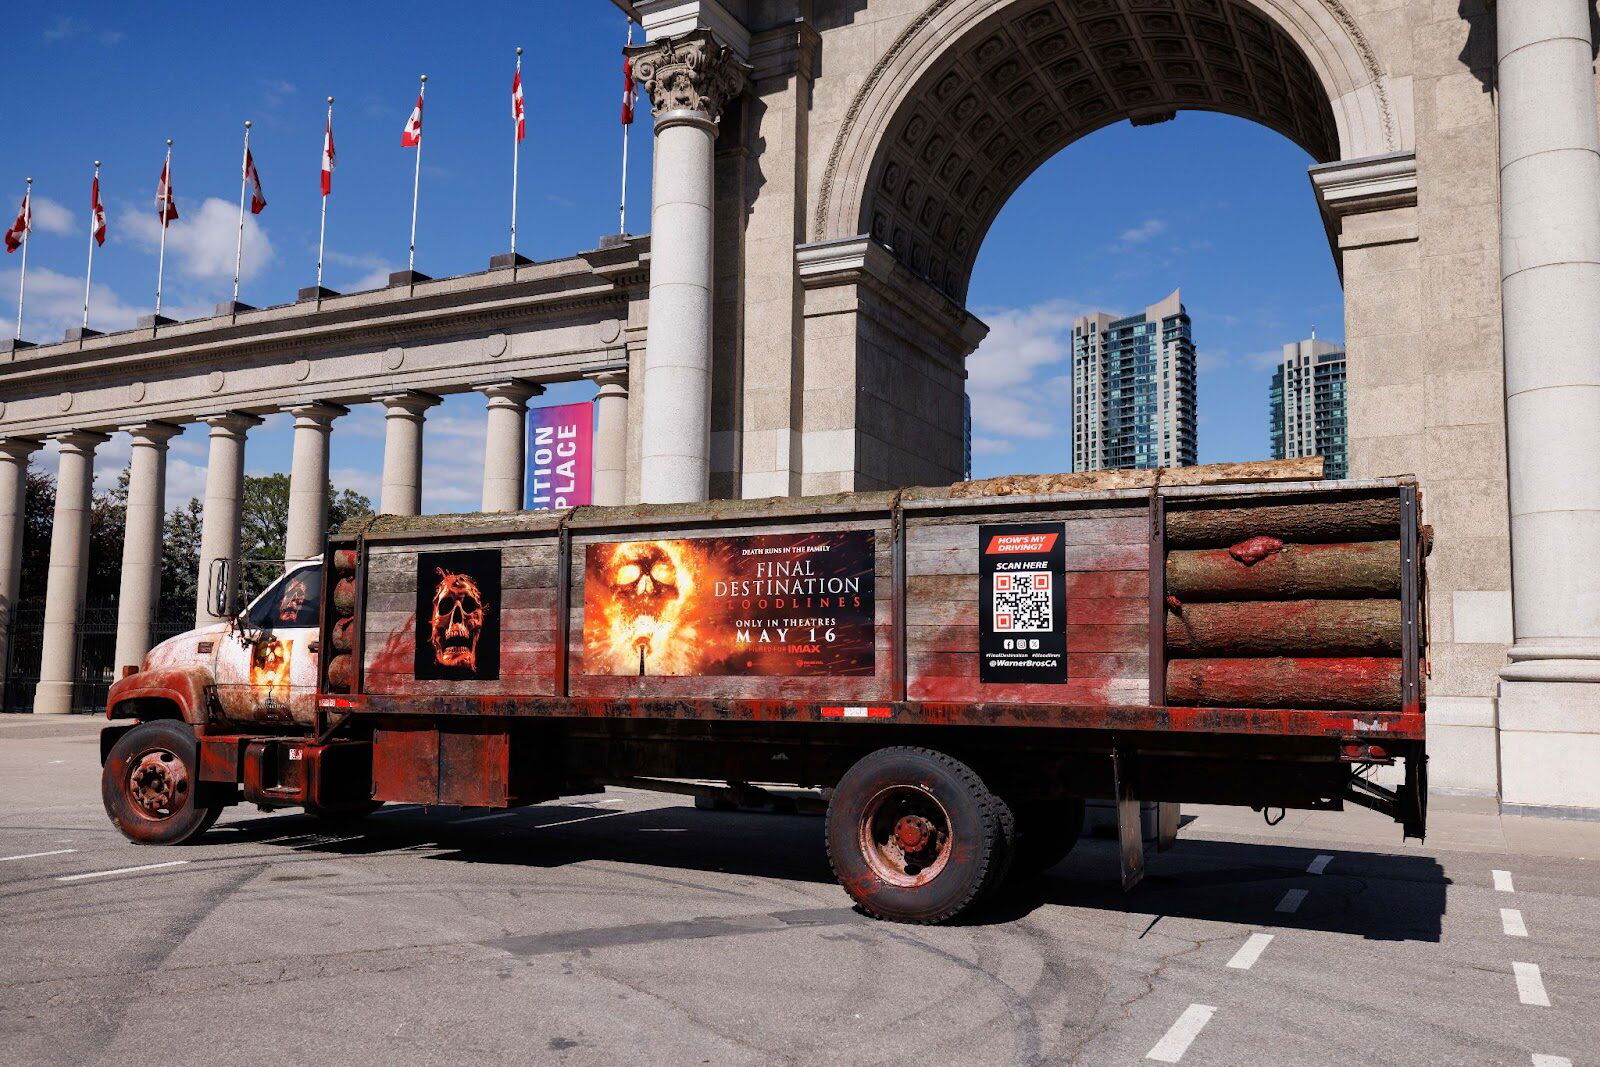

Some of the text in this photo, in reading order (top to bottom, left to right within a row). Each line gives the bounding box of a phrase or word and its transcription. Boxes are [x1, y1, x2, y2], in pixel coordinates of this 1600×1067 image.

[554, 424, 577, 510] PLACE
[998, 535, 1047, 544] HOW'S MY
[742, 548, 764, 556] DEATH
[764, 547, 782, 555] RUNS
[806, 545, 831, 553] FAMILY
[997, 543, 1043, 552] DRIVING?
[756, 560, 815, 578] FINAL
[996, 560, 1049, 571] SCAN HERE
[714, 576, 860, 597] DESTINATION
[735, 617, 837, 628] ONLY IN THEATRES
[735, 627, 837, 643] MAY 16
[787, 644, 821, 653] IMAX
[989, 659, 1058, 668] @WarnerBrosCA
